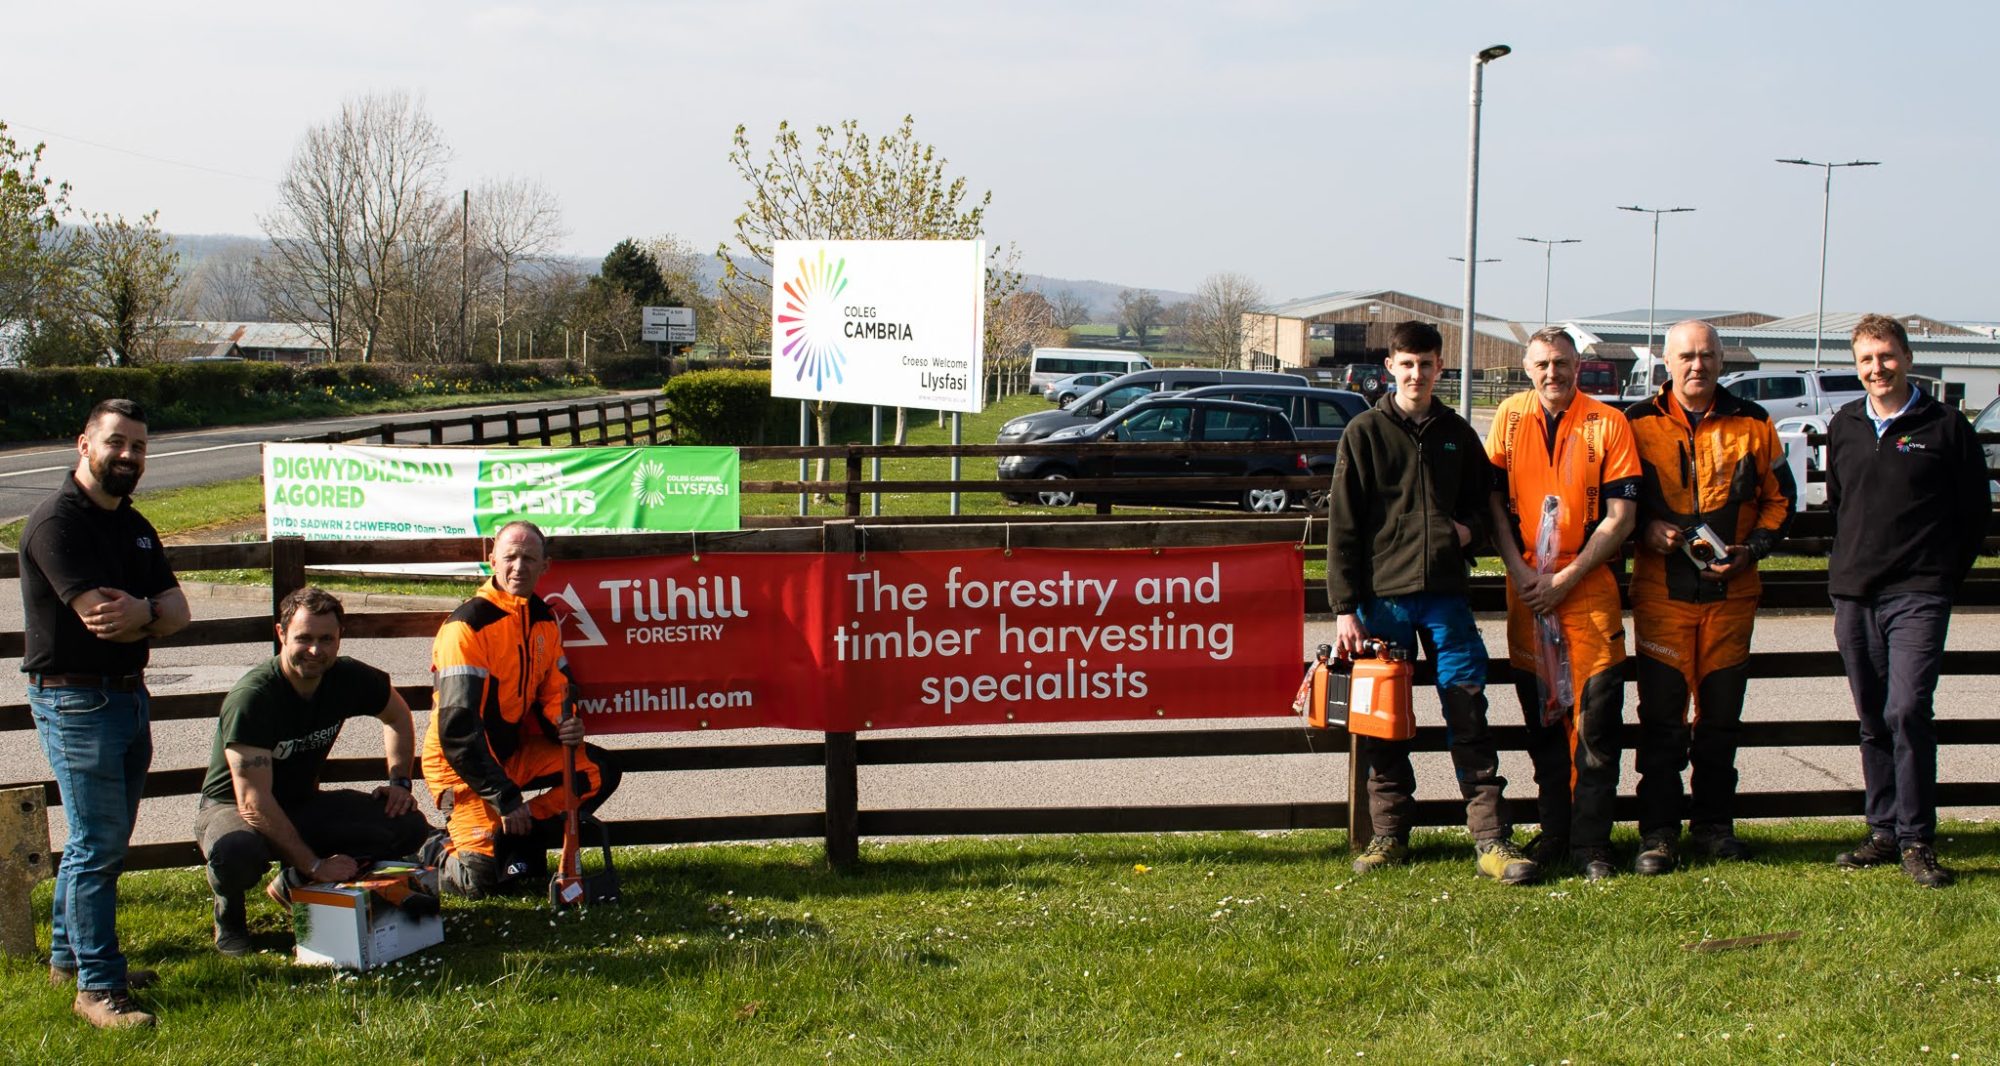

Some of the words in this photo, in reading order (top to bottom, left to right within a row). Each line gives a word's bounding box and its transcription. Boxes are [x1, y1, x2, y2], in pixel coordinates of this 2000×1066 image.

[844, 306, 876, 318] COLEG
[844, 321, 913, 341] CAMBRIA
[902, 355, 928, 367] Croeso
[932, 356, 968, 369] Welcome
[921, 371, 967, 392] Llysfasi
[491, 462, 564, 486] OPEN
[273, 484, 365, 508] AGORED
[667, 483, 729, 496] LLYSFASI
[490, 489, 597, 515] EVENTS
[272, 517, 298, 528] DYDD
[300, 518, 343, 530] SADWRN
[345, 520, 351, 530] 2
[353, 521, 412, 533] CHWEFROR
[414, 524, 437, 534] 10am
[443, 525, 466, 535] 12pm
[599, 575, 748, 623] Tilhill
[847, 570, 928, 613] The
[944, 566, 1118, 616] forestry
[1134, 562, 1221, 605] and
[626, 624, 724, 644] FORESTRY
[834, 616, 981, 661] timber
[1000, 611, 1234, 660] harvesting
[920, 658, 1149, 714] specialists
[576, 686, 753, 714] w.tilhill.com
